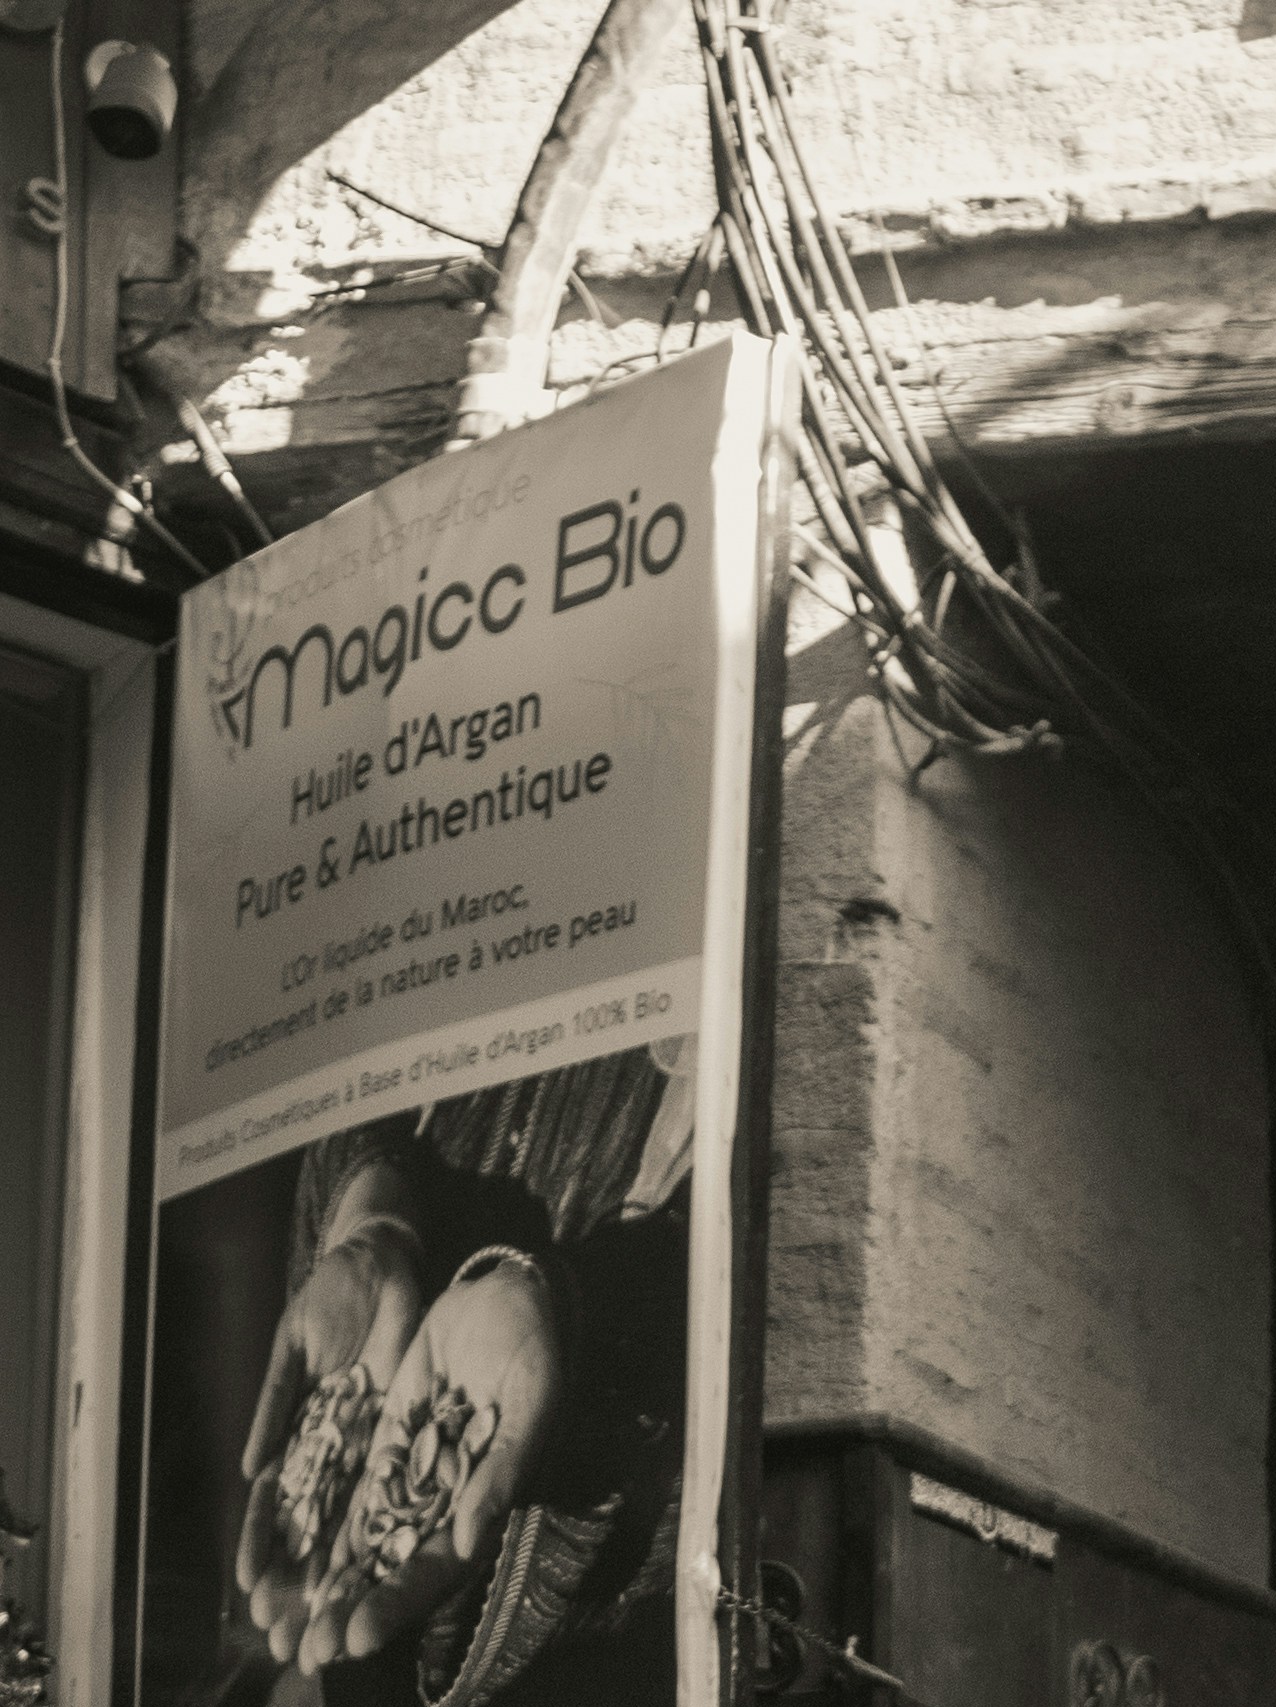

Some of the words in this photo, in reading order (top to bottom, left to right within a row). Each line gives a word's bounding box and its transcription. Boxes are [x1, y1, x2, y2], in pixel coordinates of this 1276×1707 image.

[221, 565, 528, 749] Magicc
[552, 487, 687, 614] Bio
[289, 748, 374, 825] Huile
[383, 690, 541, 777] d'Argan
[235, 865, 307, 930] Pure
[316, 836, 341, 889] &
[347, 751, 613, 875] Authentique
[205, 1000, 318, 1073] directement
[322, 987, 350, 1021] de
[355, 975, 374, 1008] la
[380, 952, 460, 997] nature
[468, 938, 483, 972] à
[491, 922, 561, 963] votre
[569, 900, 637, 949] peau
[323, 921, 395, 974] liquide
[401, 907, 434, 943] du
[359, 1067, 403, 1098] Base
[486, 1022, 565, 1060] d'Argan
[573, 997, 626, 1036] 100%
[634, 989, 672, 1020] Bio
